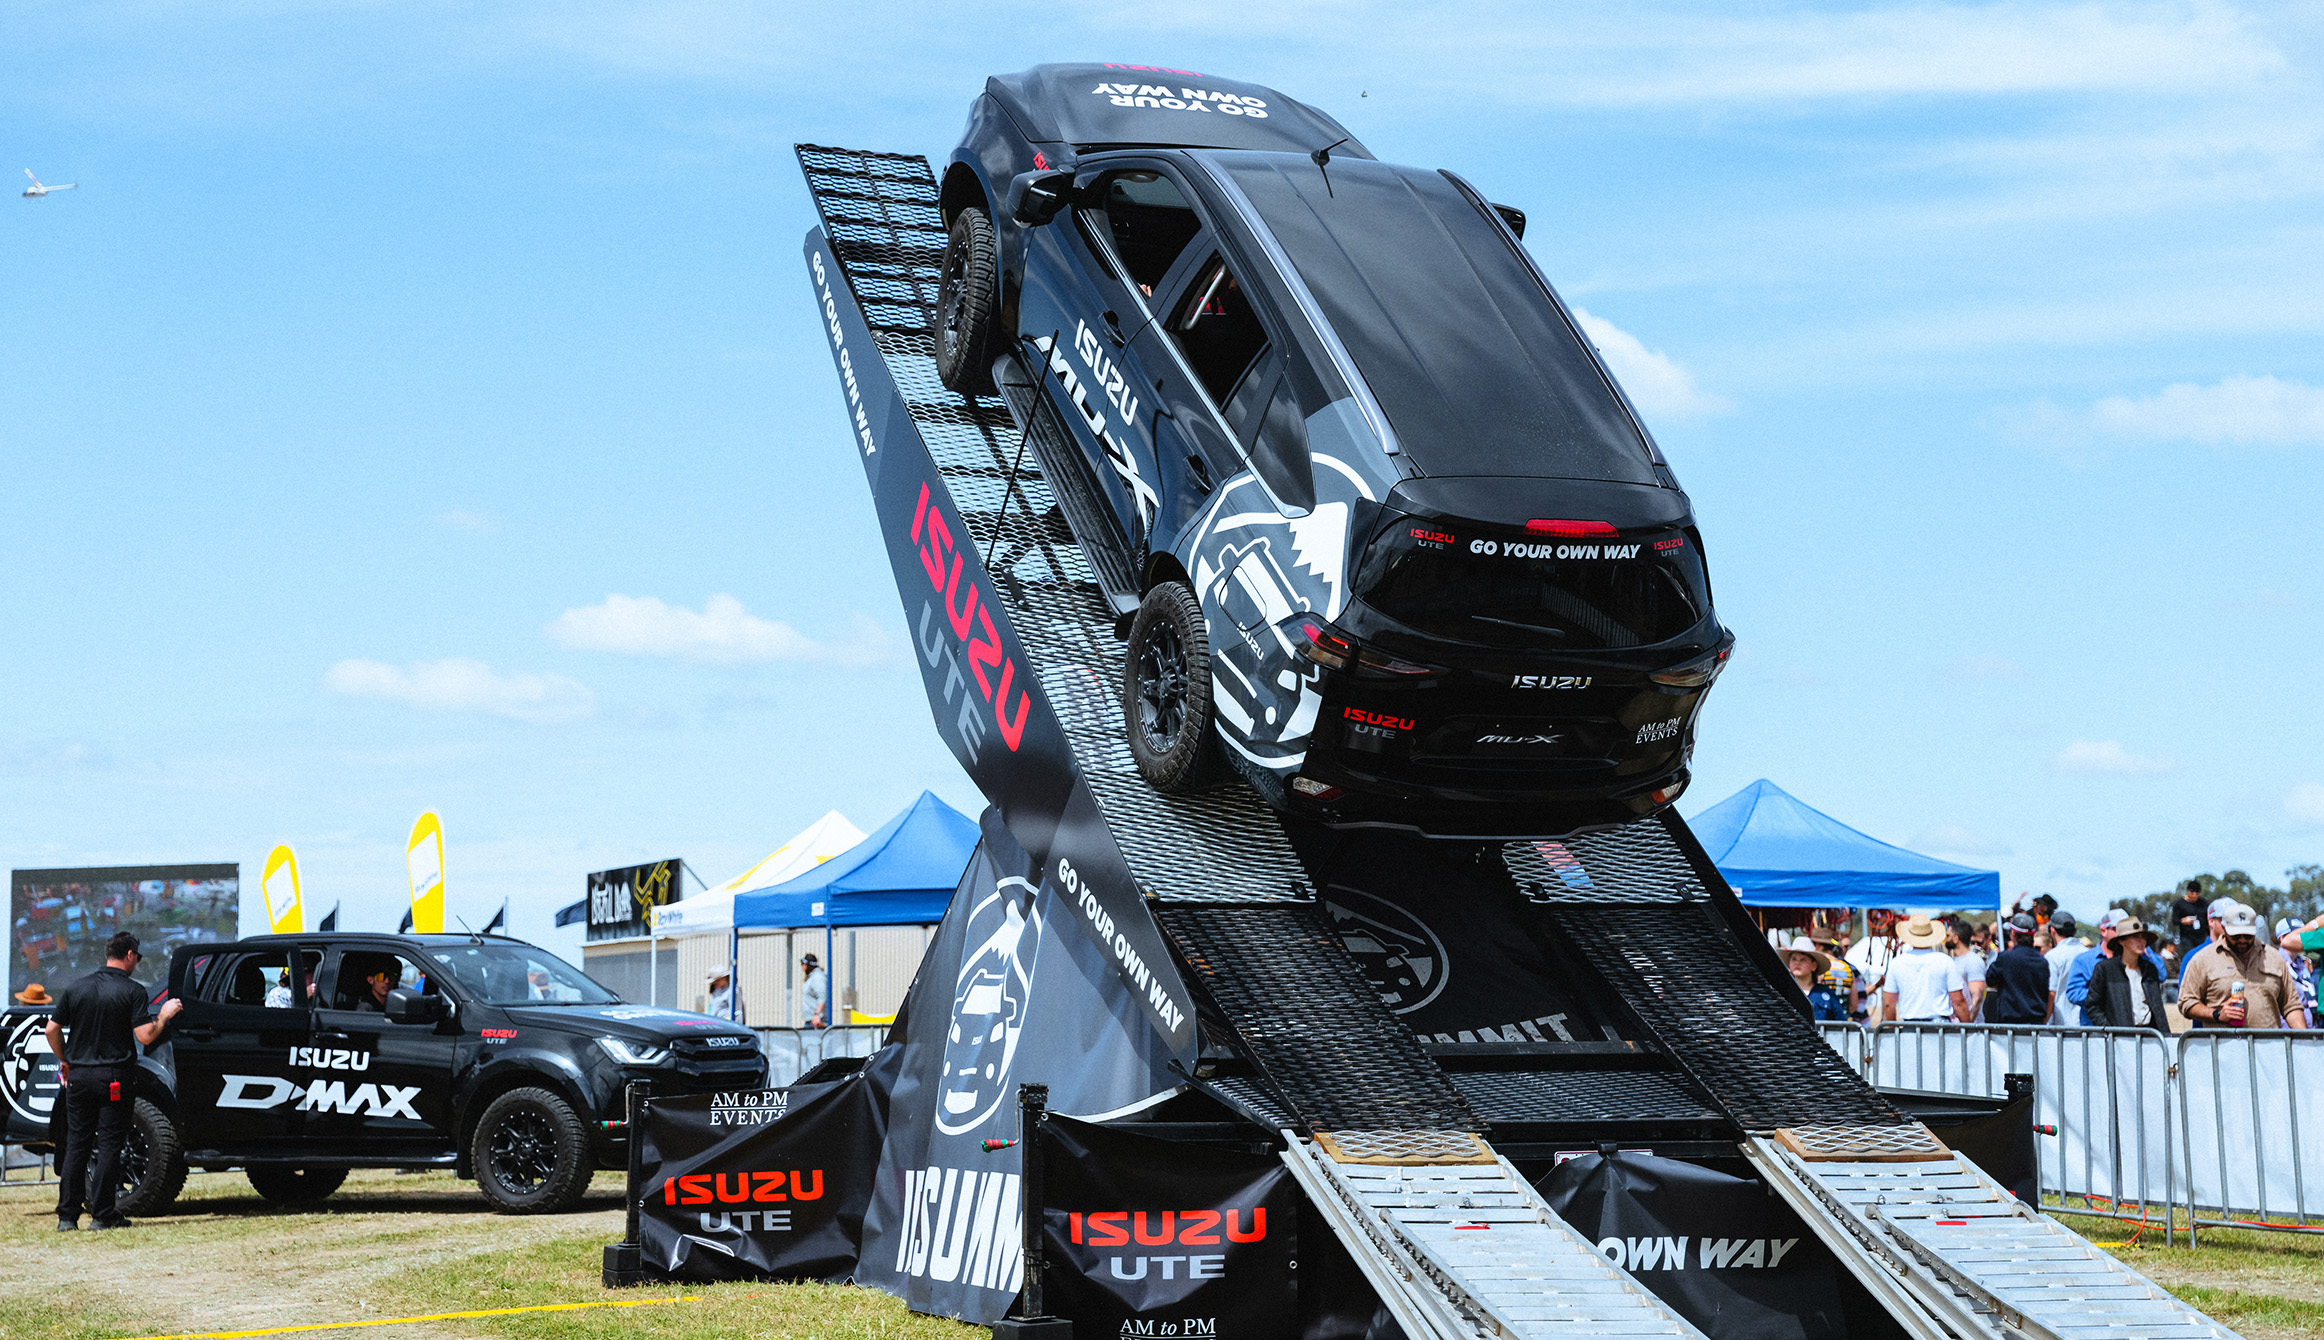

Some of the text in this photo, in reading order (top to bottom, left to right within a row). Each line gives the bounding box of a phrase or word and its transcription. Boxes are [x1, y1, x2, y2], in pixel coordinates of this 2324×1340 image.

[1091, 82, 1267, 108] OWN WAY
[1109, 94, 1269, 119] GO YOUR
[812, 251, 877, 456] GO YOUR OWN WAY
[1074, 318, 1139, 427] ISUZU
[1409, 528, 1455, 544] ISUZU
[1417, 540, 1445, 550] UTE
[1653, 537, 1684, 551] ISUZU
[1469, 539, 1642, 560] GO YOUR OWN WAY
[1660, 548, 1680, 558] UTE
[909, 480, 1032, 753] ISUZU
[918, 599, 987, 766] UTE
[1511, 675, 1592, 690] ISUZU
[1343, 706, 1415, 731] ISUZU
[1638, 716, 1682, 733] AM to PM
[1354, 723, 1396, 740] UTE
[1635, 726, 1678, 745] EVENTS
[1058, 858, 1185, 1034] GO YOUR OWN WAY
[481, 1028, 518, 1038] ISUZU
[705, 1037, 740, 1048] ISUZU
[39, 1064, 60, 1072] ISUZU
[288, 1046, 370, 1072] ISUZU
[215, 1074, 423, 1120] D-MAX
[710, 1091, 789, 1107] AM to PM
[710, 1109, 787, 1126] EVENTS
[663, 1169, 824, 1206] ISUZU
[700, 1210, 792, 1233] UTE
[1069, 1207, 1267, 1247] ISUZU
[1597, 1236, 1800, 1272] OWN WAY
[1110, 1254, 1226, 1280] UTE
[1120, 1317, 1217, 1336] AM to PM
